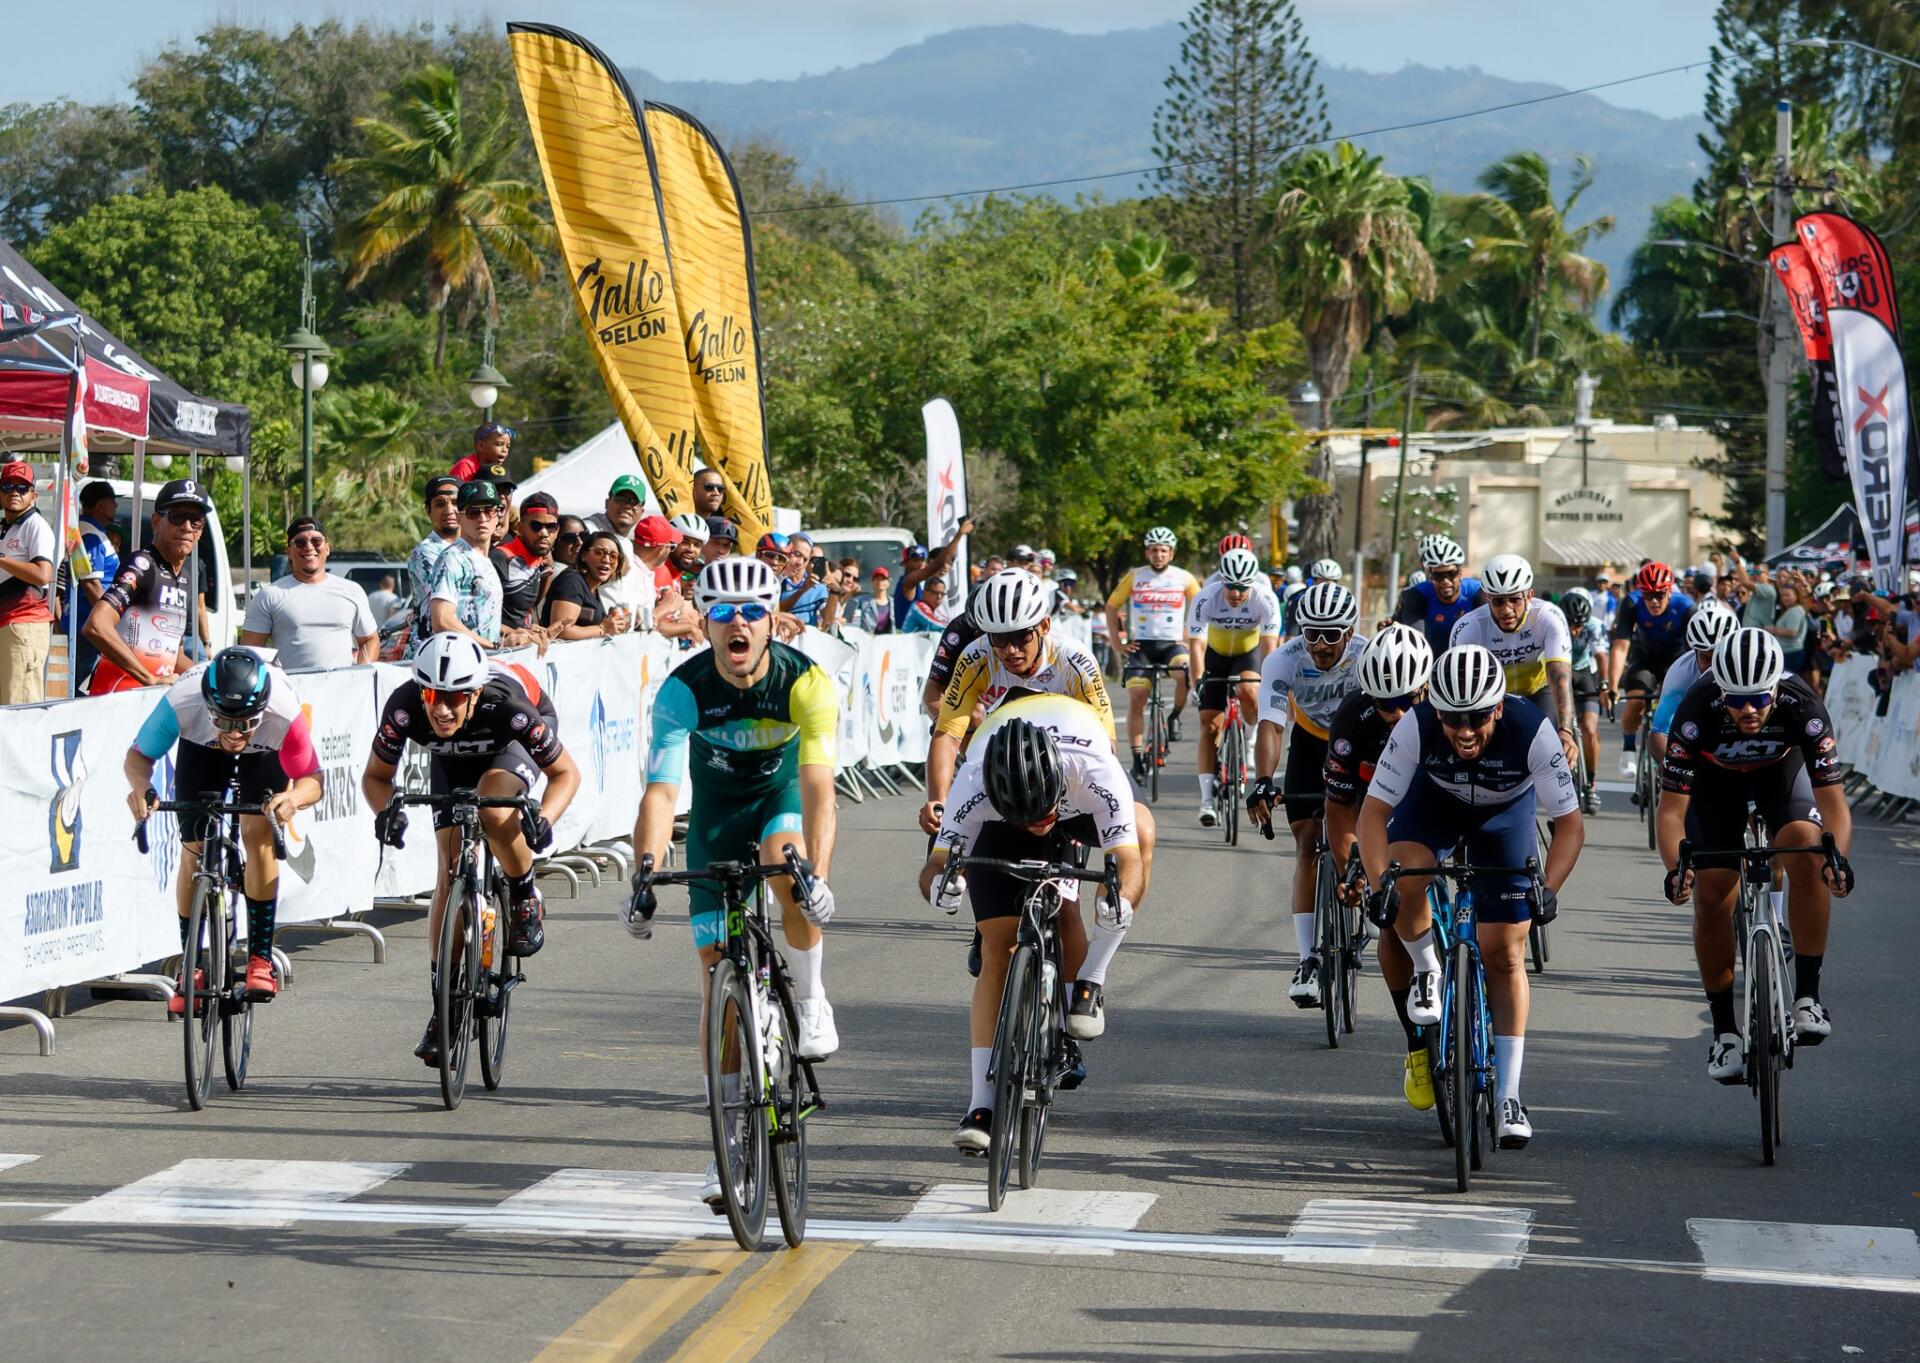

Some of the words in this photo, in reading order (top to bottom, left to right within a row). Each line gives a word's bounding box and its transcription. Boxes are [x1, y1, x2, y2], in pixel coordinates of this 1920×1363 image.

[576, 258, 664, 328] Gallo
[598, 317, 666, 346] PELÓN
[685, 309, 746, 375] Gallo
[945, 648, 987, 709] PREMIUM
[1713, 740, 1785, 758] HCT
[953, 790, 988, 824] PEGACOL
[1087, 782, 1120, 818] PEGACOL
